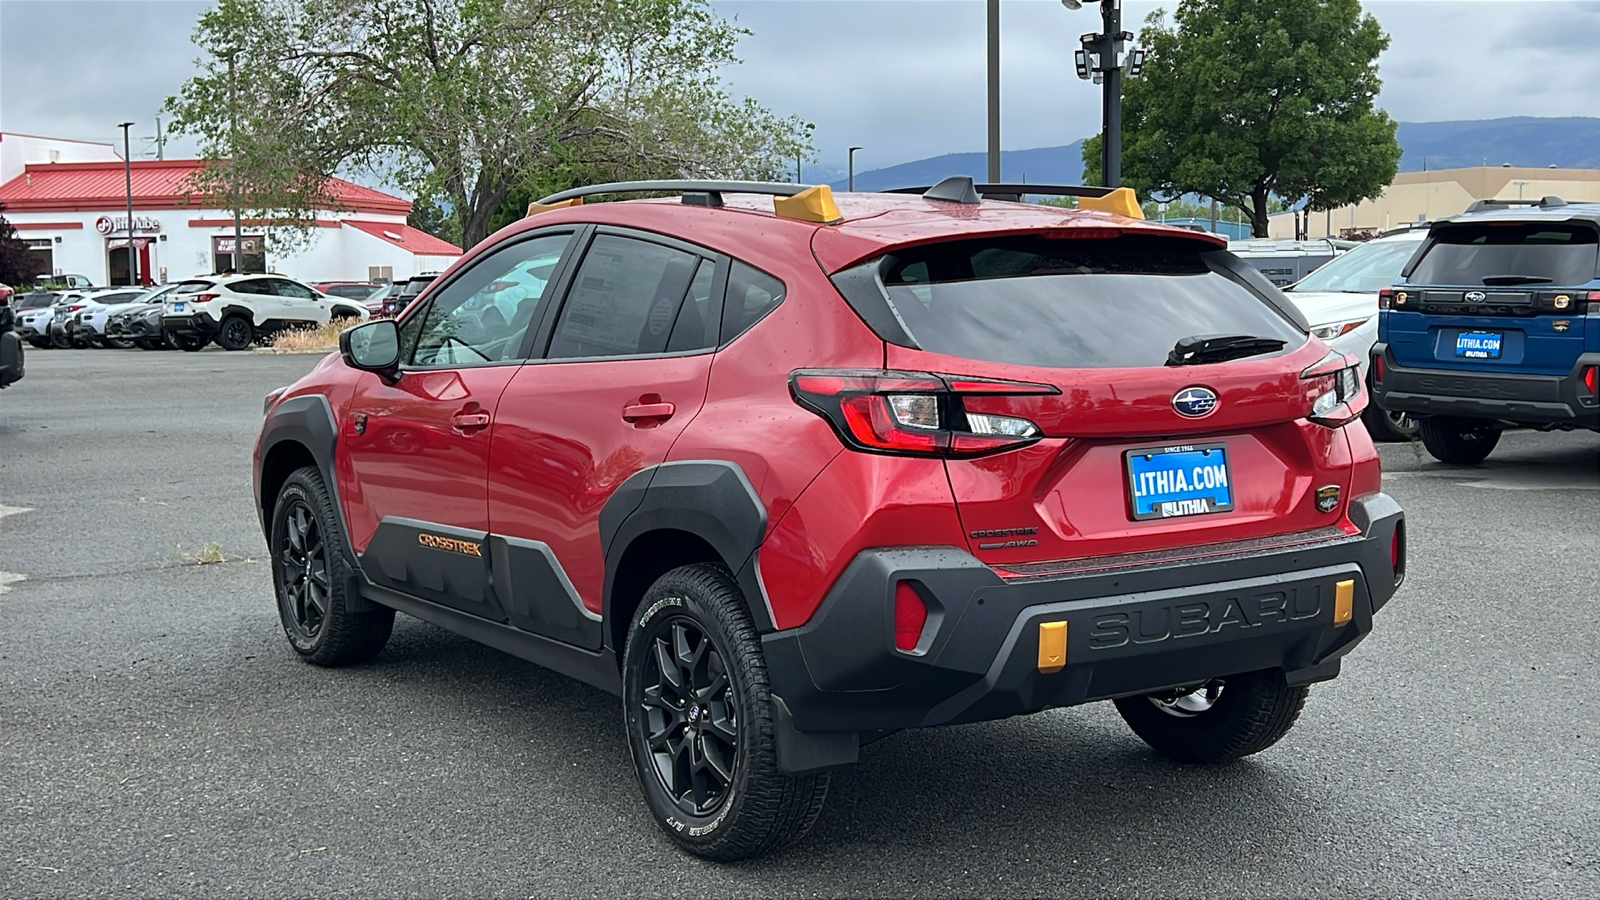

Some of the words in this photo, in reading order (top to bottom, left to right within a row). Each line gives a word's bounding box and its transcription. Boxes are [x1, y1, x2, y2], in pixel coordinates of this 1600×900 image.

[1456, 338, 1501, 350] LITHIA.COM
[1132, 464, 1228, 496] LITHIA.COM
[1173, 499, 1210, 516] LITHIA
[970, 526, 1039, 538] CROSSTREK
[418, 533, 482, 556] CROSSTREK
[1003, 539, 1038, 548] AWD
[1088, 584, 1321, 650] SUBARU
